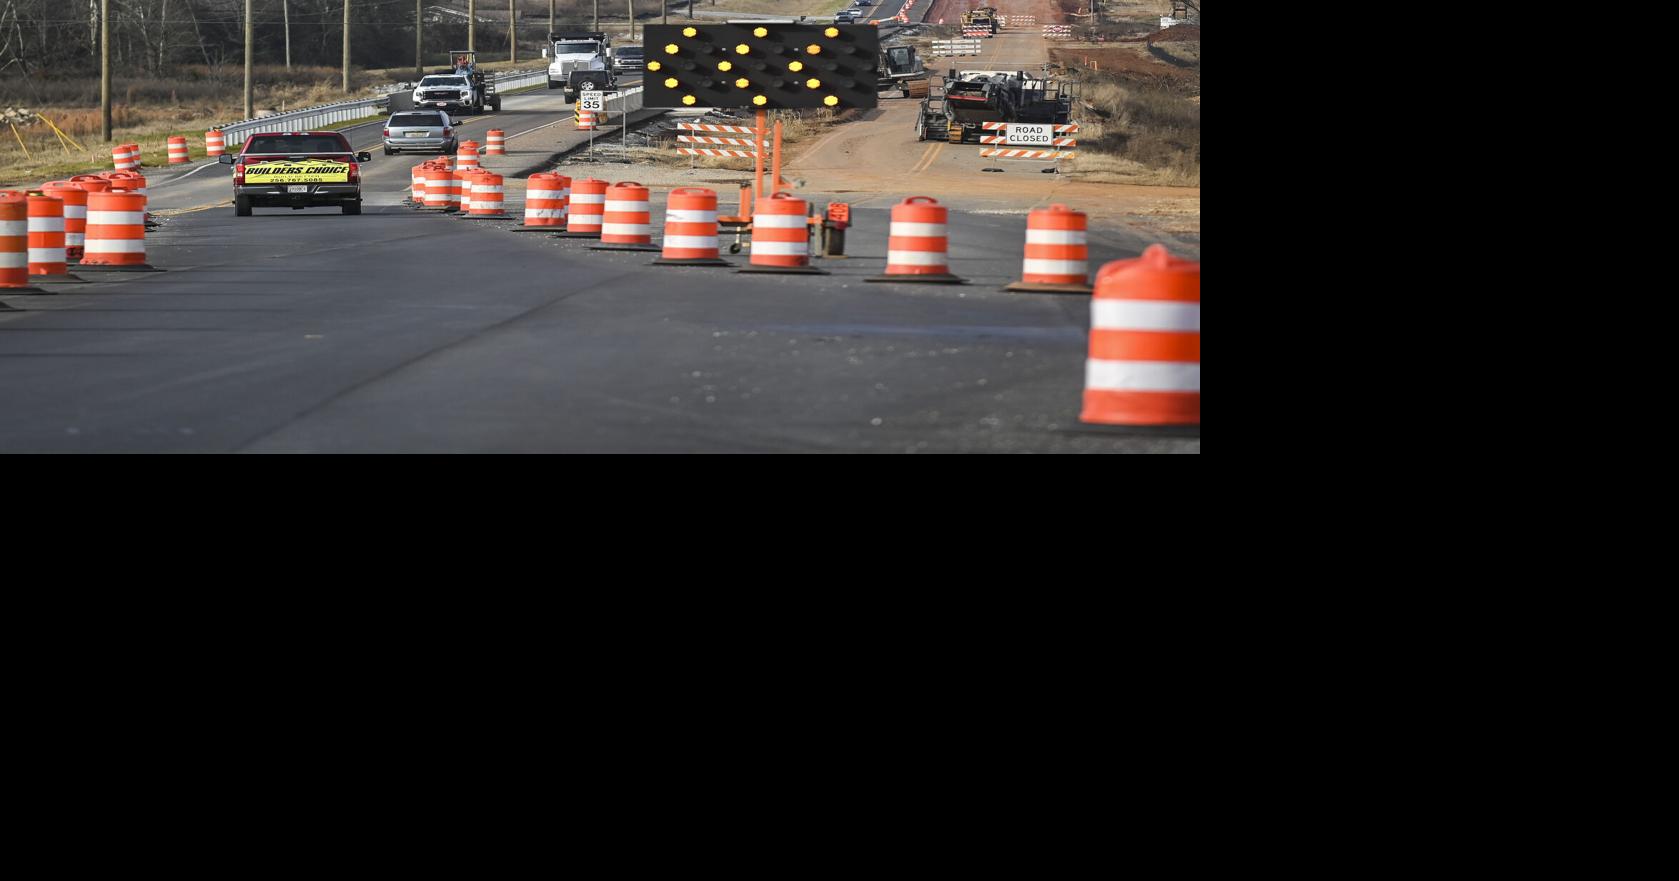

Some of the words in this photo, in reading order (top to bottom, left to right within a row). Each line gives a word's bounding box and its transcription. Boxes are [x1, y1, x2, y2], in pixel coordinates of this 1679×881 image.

[583, 100, 600, 109] 35
[1015, 126, 1043, 134] ROAD
[1009, 134, 1049, 142] CLOSED
[246, 167, 303, 175] BUILDERS
[305, 166, 350, 174] CHOICE
